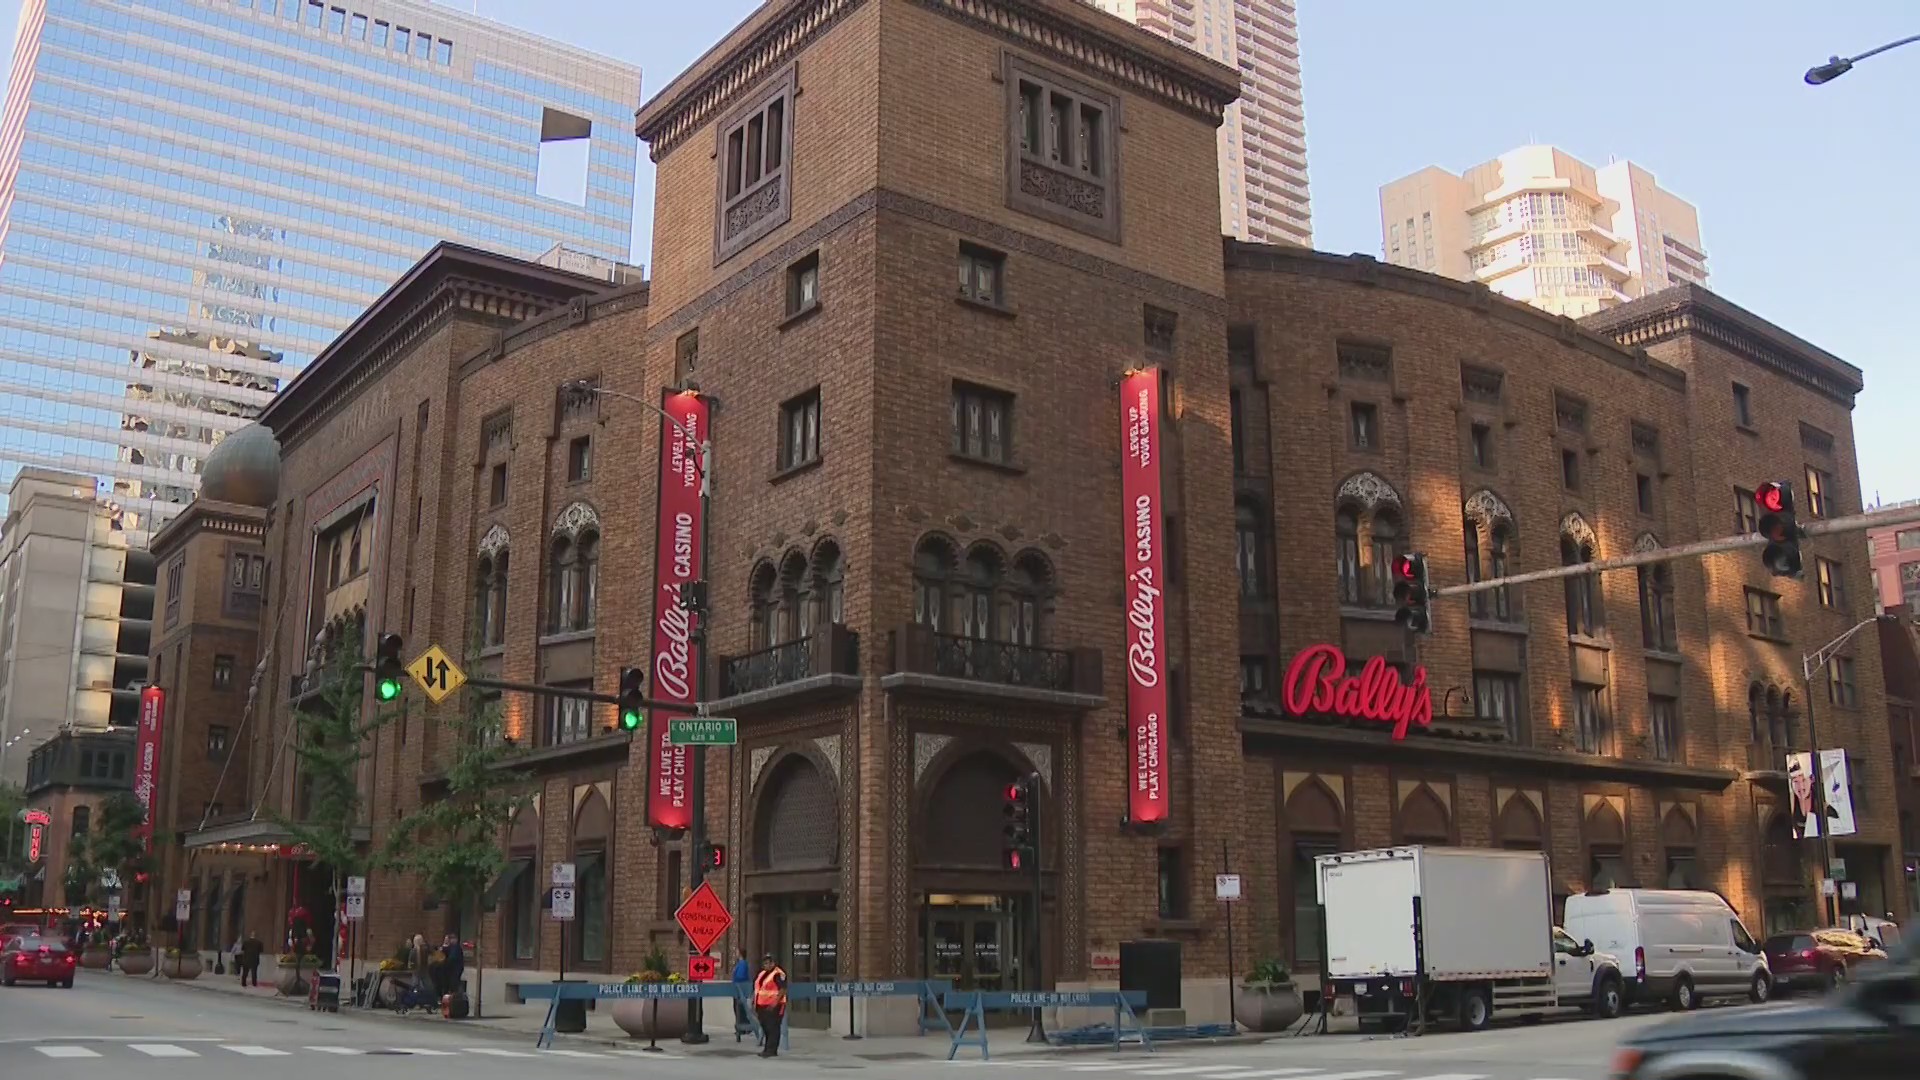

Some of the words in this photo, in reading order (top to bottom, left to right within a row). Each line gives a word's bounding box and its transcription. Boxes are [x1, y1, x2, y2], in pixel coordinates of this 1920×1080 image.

[1128, 406, 1138, 422] UP
[1138, 388, 1149, 435] GAMING
[685, 412, 698, 458] AING
[1129, 422, 1139, 458] LEVEL
[672, 440, 683, 473] LEVEL
[1140, 436, 1150, 468] YOUR
[684, 458, 696, 487] YOUR
[1136, 494, 1152, 562] CASINO
[674, 512, 693, 577] CASINO
[1129, 566, 1161, 688] Bally's
[1283, 643, 1433, 741] Bally's
[662, 732, 673, 748] TO
[679, 721, 722, 732] ONTARIO
[724, 722, 734, 731] ST
[1137, 725, 1147, 742] TO
[1147, 712, 1158, 767] CHICAGO
[661, 750, 672, 776] LIVE
[674, 744, 686, 775] CHIC
[1137, 743, 1148, 770] LIVE
[660, 778, 672, 796] WE
[672, 778, 685, 808] PLAY
[1138, 772, 1148, 791] WE
[1148, 770, 1159, 800] PLAY
[680, 912, 728, 923] CONSTRUCTION
[696, 901, 712, 909] ROAD
[692, 927, 714, 935] AHEAD
[599, 983, 624, 993] POLICE
[661, 983, 674, 993] NOT
[676, 983, 699, 993] CROSS
